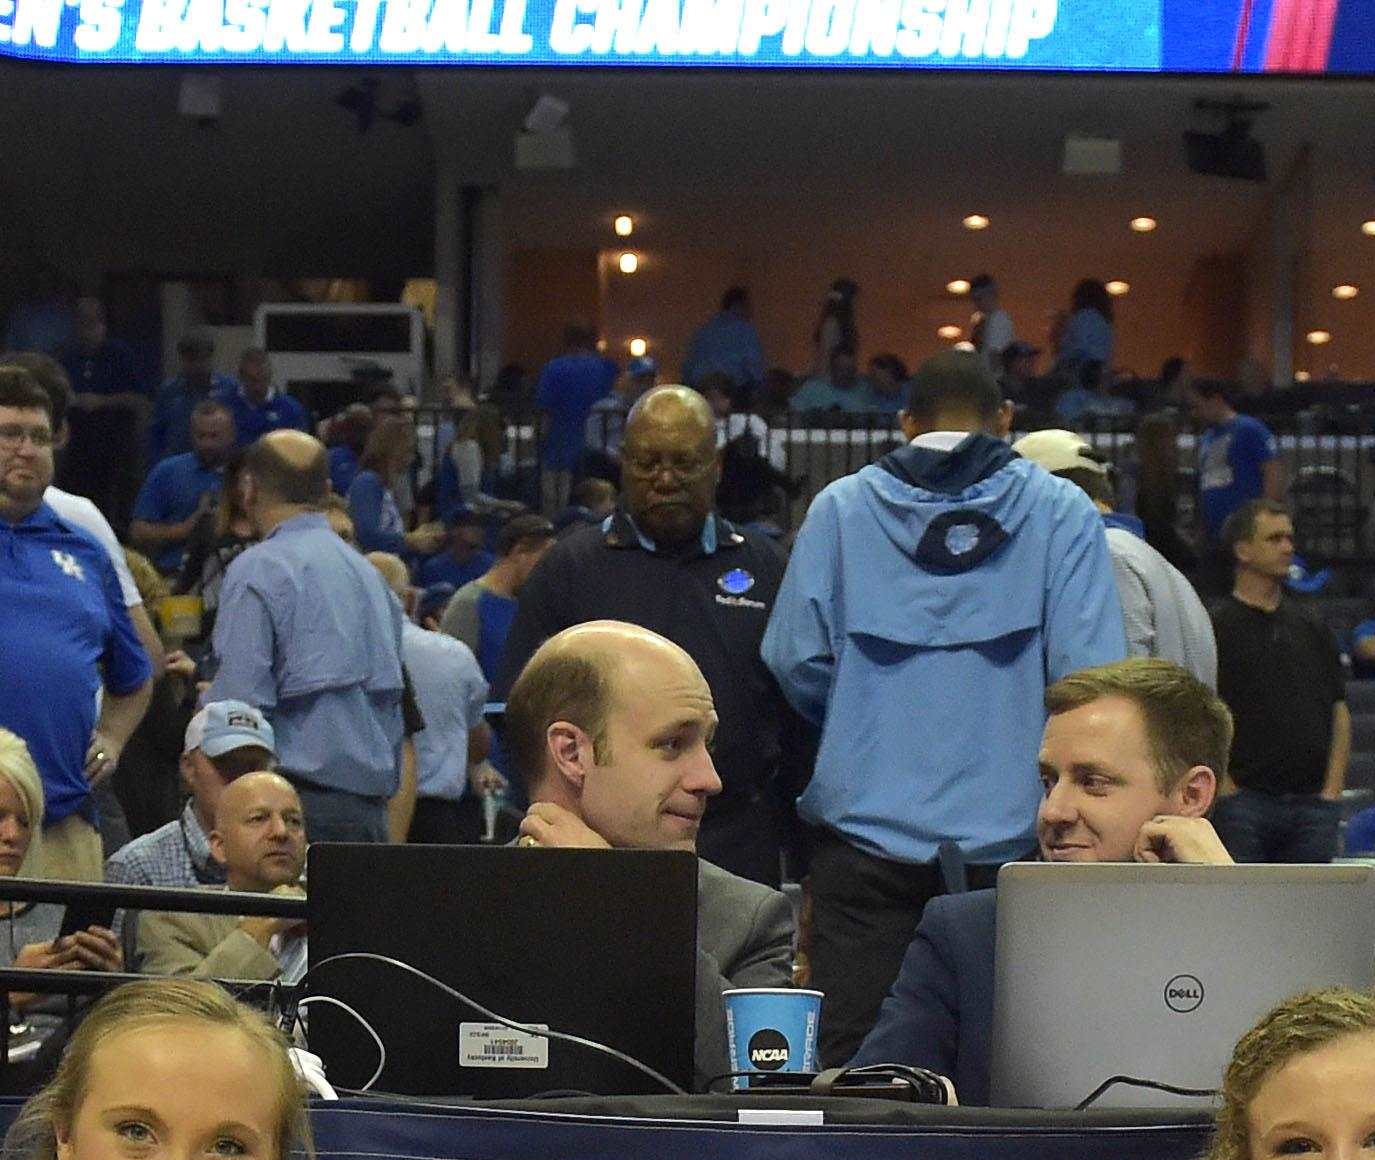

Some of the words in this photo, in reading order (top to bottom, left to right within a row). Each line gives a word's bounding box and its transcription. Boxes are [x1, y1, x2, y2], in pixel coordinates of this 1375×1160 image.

[134, 0, 533, 52] BASKETBALL
[550, 0, 1058, 57] CHAMPIONSHIP
[1169, 988, 1200, 999] DELL
[751, 1048, 788, 1062] NCAA
